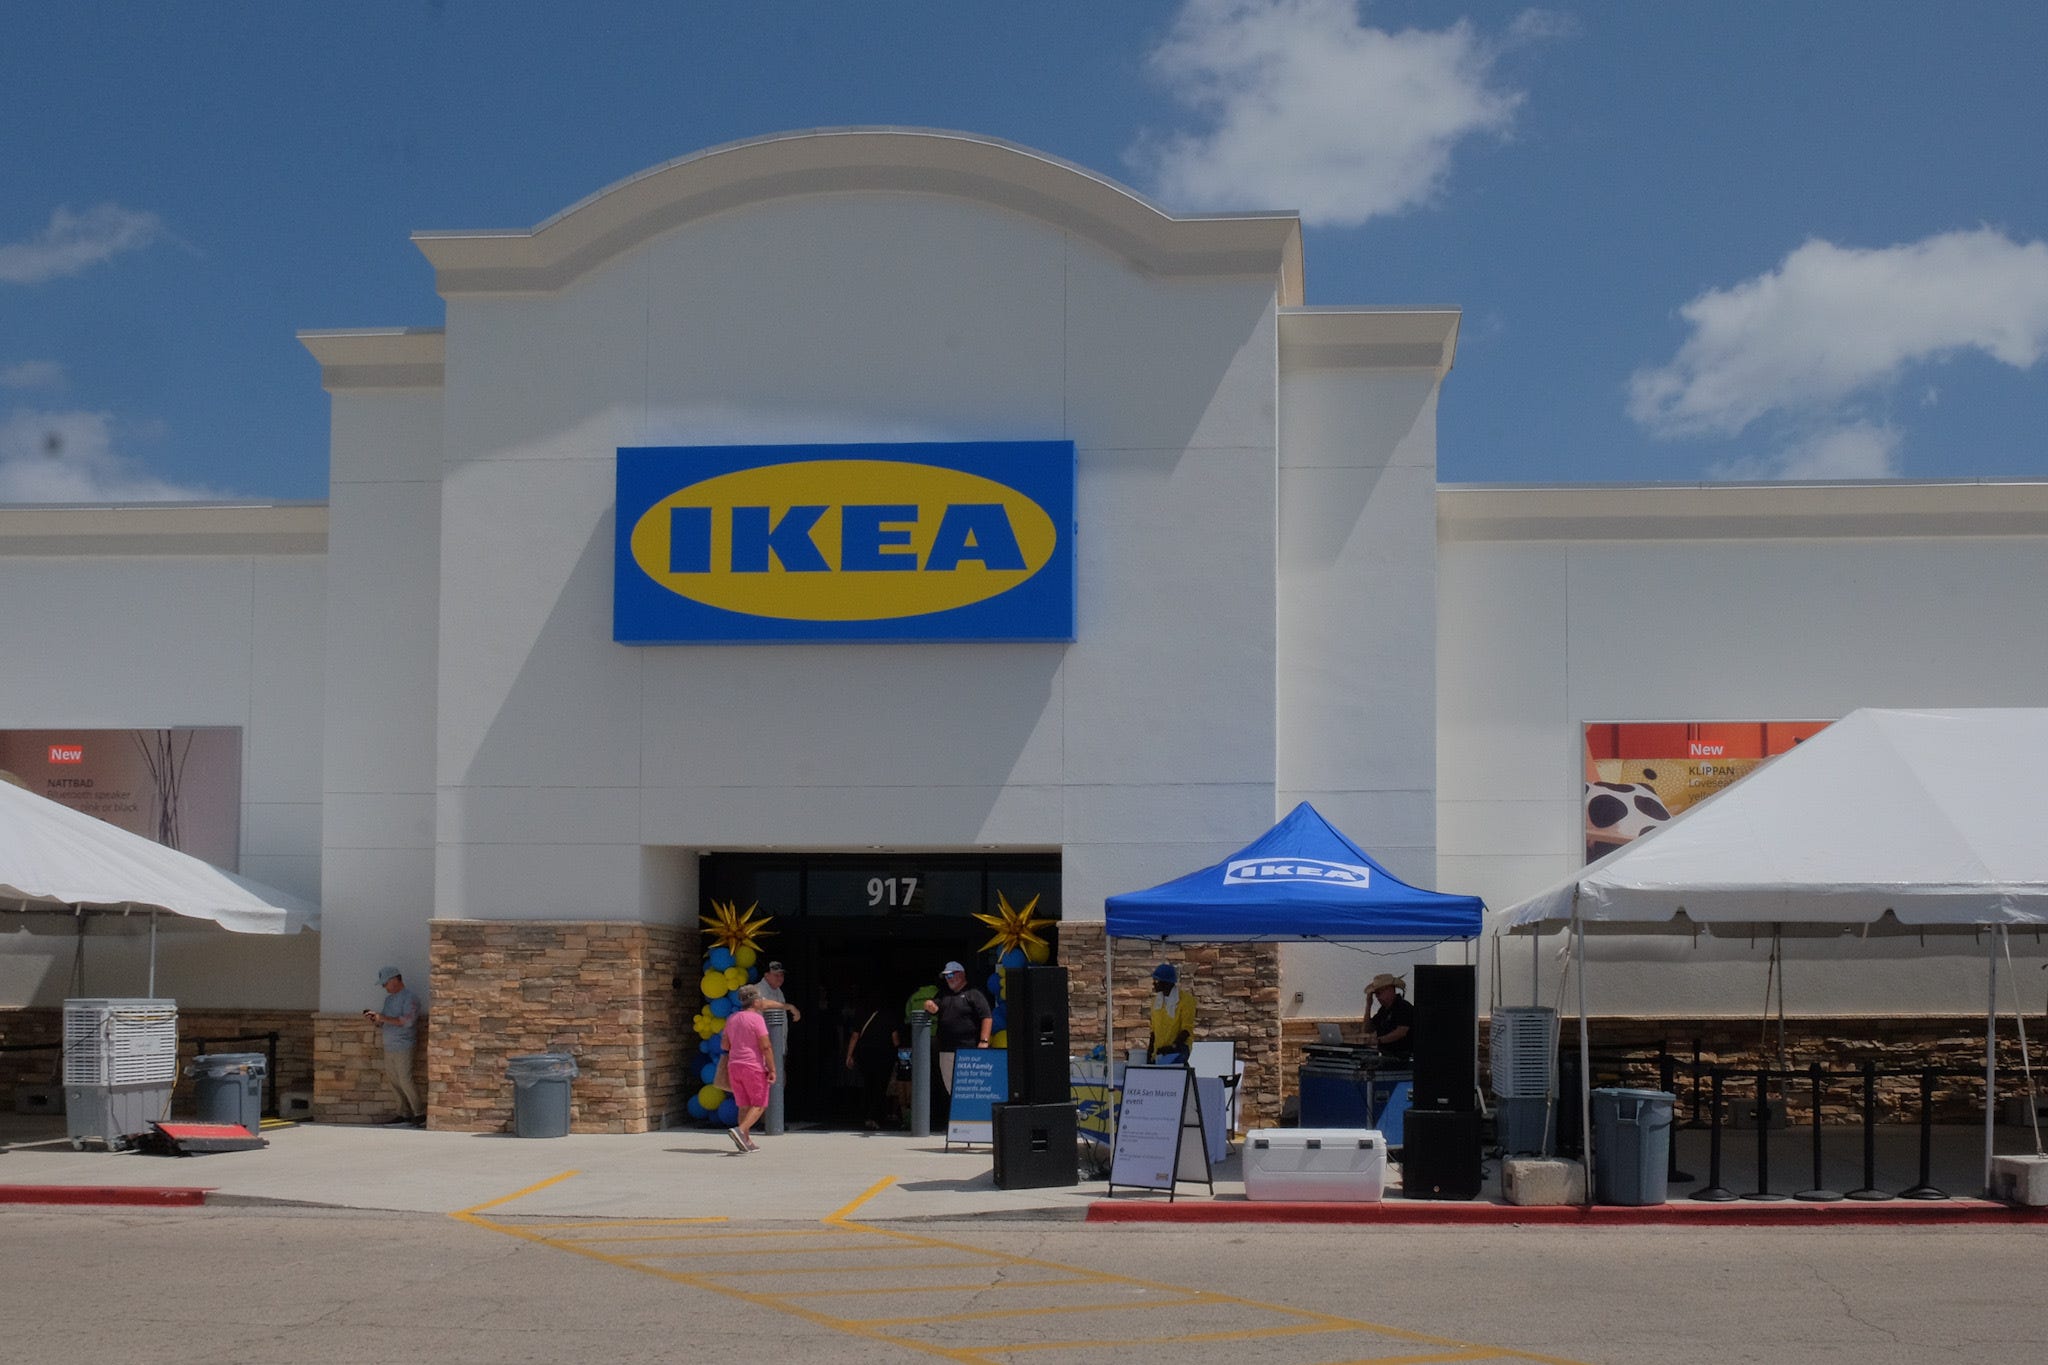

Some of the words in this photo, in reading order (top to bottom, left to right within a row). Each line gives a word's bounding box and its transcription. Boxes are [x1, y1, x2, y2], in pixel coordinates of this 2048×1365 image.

[669, 503, 1028, 573] IKEA
[51, 748, 82, 761] New
[1691, 743, 1724, 756] New
[1688, 766, 1735, 776] KLIPPAN
[47, 778, 94, 788] NATTBAD
[1240, 865, 1356, 881] IKEA
[867, 877, 918, 906] 917
[957, 1062, 971, 1070] IKEA
[972, 1062, 993, 1071] Family
[1126, 1088, 1142, 1097] IKEA
[1142, 1089, 1154, 1097] San
[1154, 1089, 1177, 1098] Marcos
